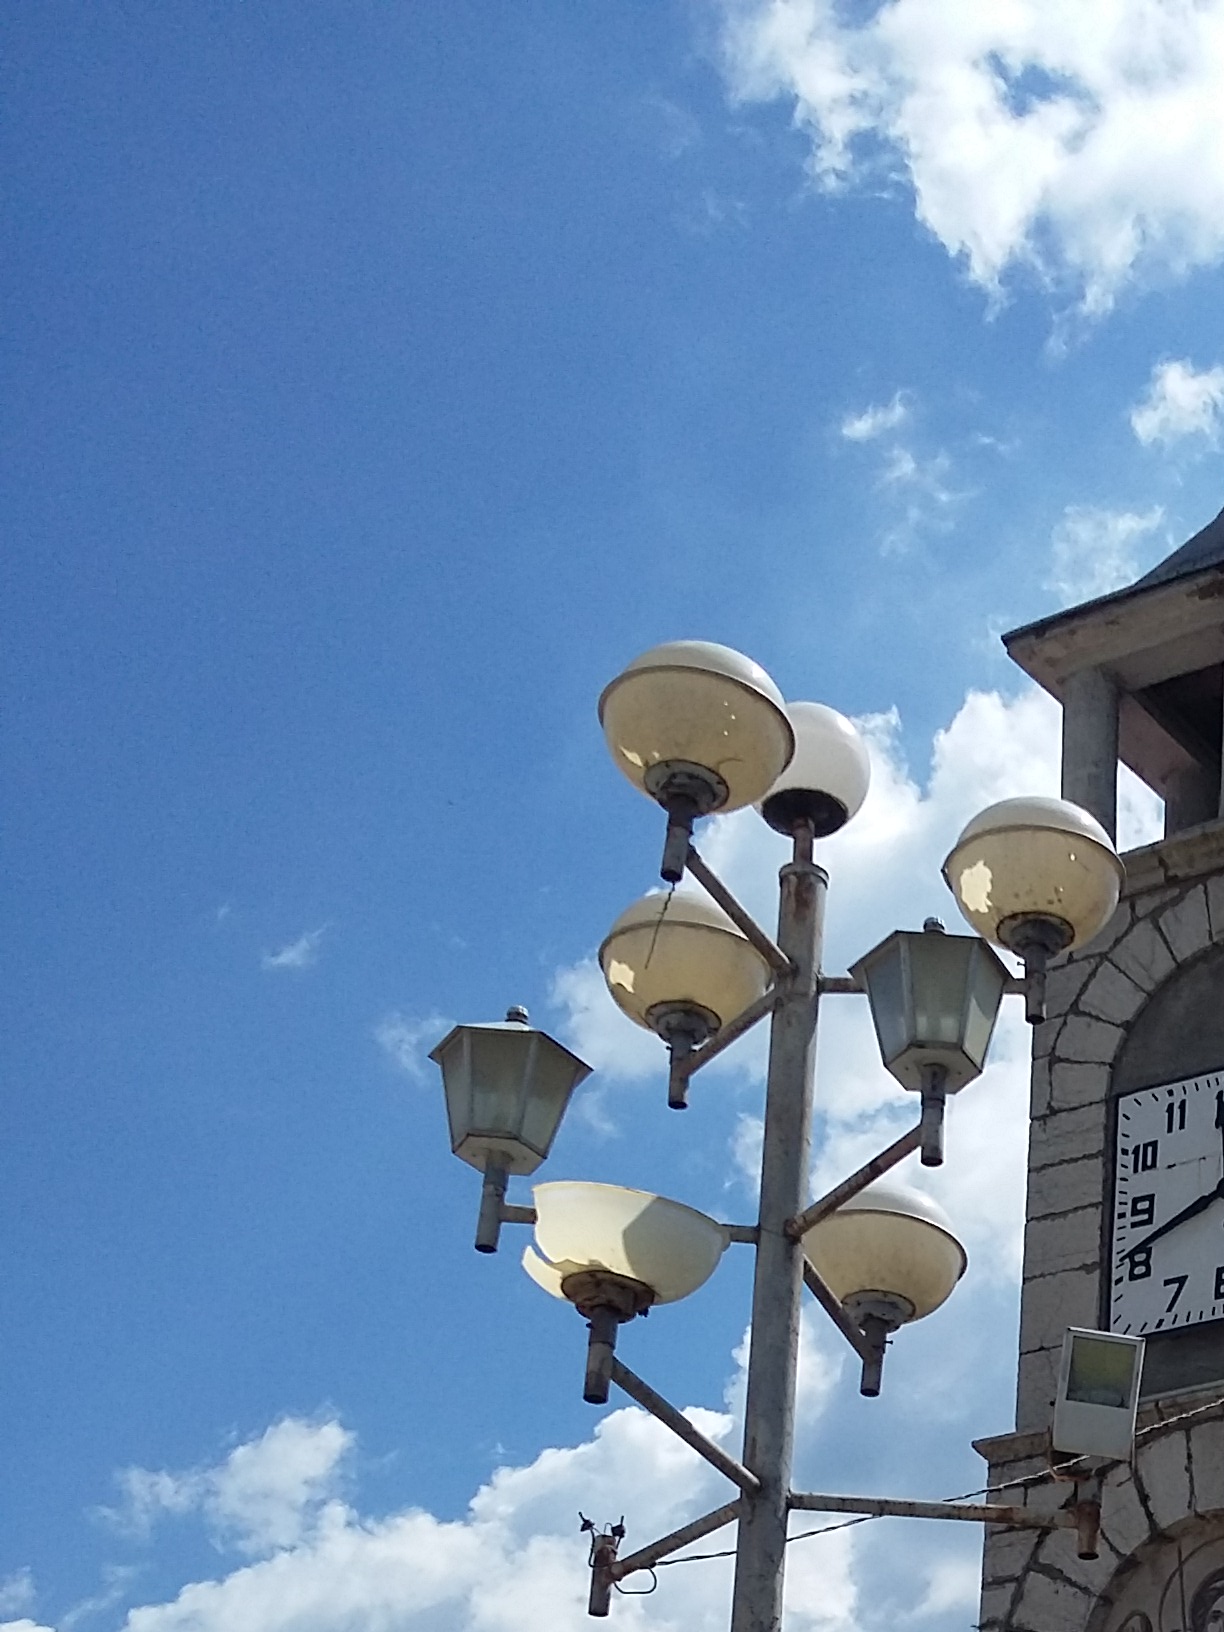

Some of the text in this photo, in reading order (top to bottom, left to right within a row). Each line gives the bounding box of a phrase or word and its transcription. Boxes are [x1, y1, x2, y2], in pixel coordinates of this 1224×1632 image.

[1165, 1099, 1186, 1133] 11
[1132, 1139, 1158, 1174] 10
[1130, 1193, 1155, 1229] 9
[1128, 1246, 1152, 1282] 8
[1163, 1275, 1189, 1312] 7
